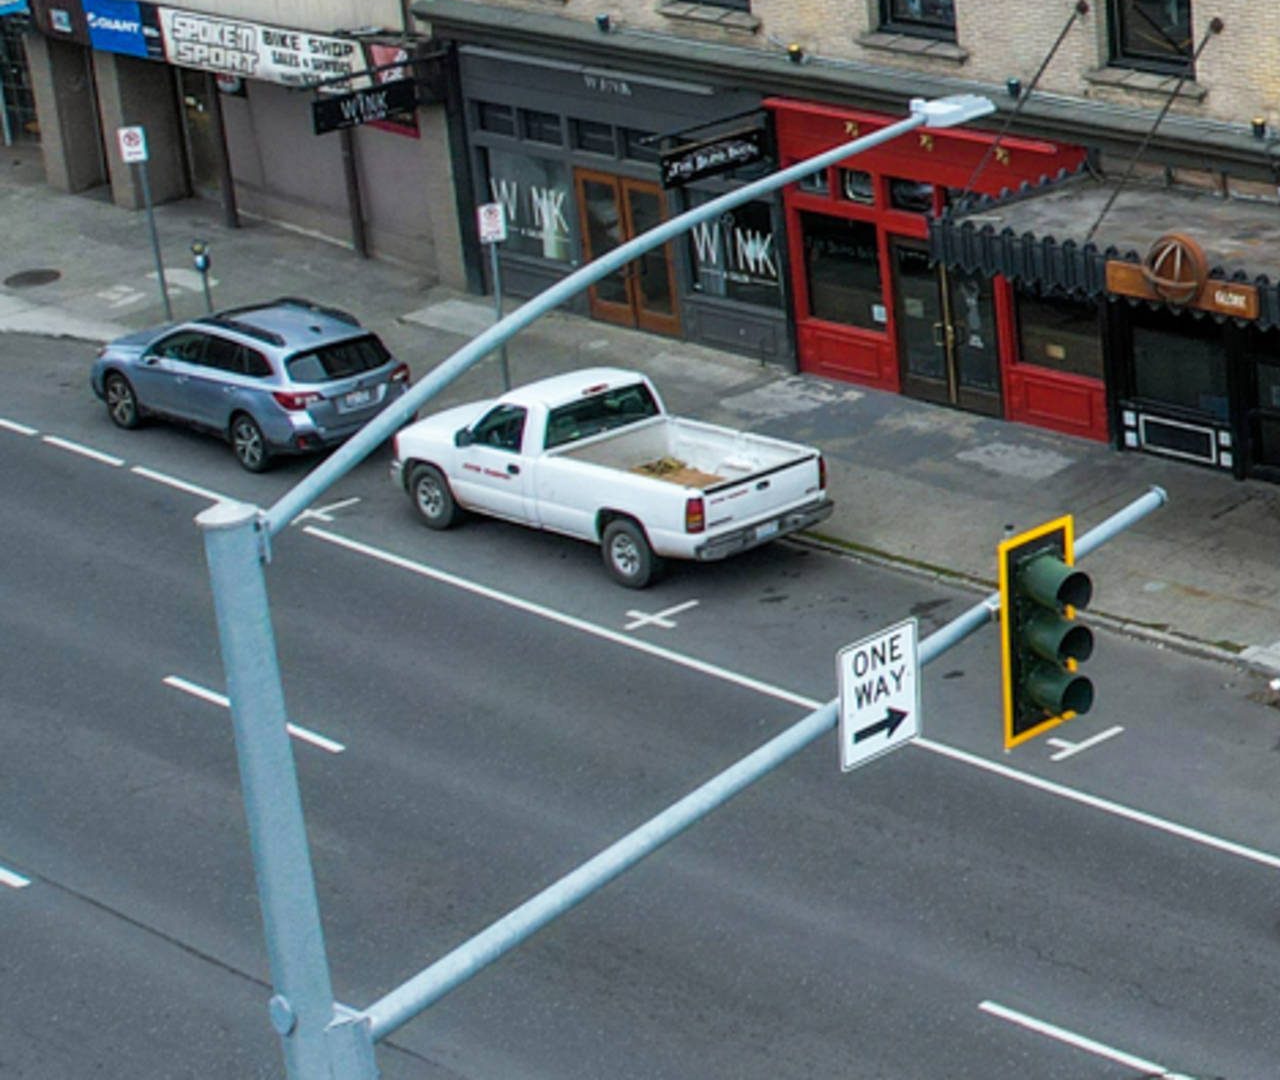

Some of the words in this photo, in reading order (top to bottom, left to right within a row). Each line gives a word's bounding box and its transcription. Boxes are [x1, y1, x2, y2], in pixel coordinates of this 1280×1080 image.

[178, 42, 259, 74] SPORT
[262, 30, 302, 52] BIKE
[308, 38, 354, 58] SHOP
[853, 634, 903, 677] ONE
[854, 664, 906, 710] WAY
